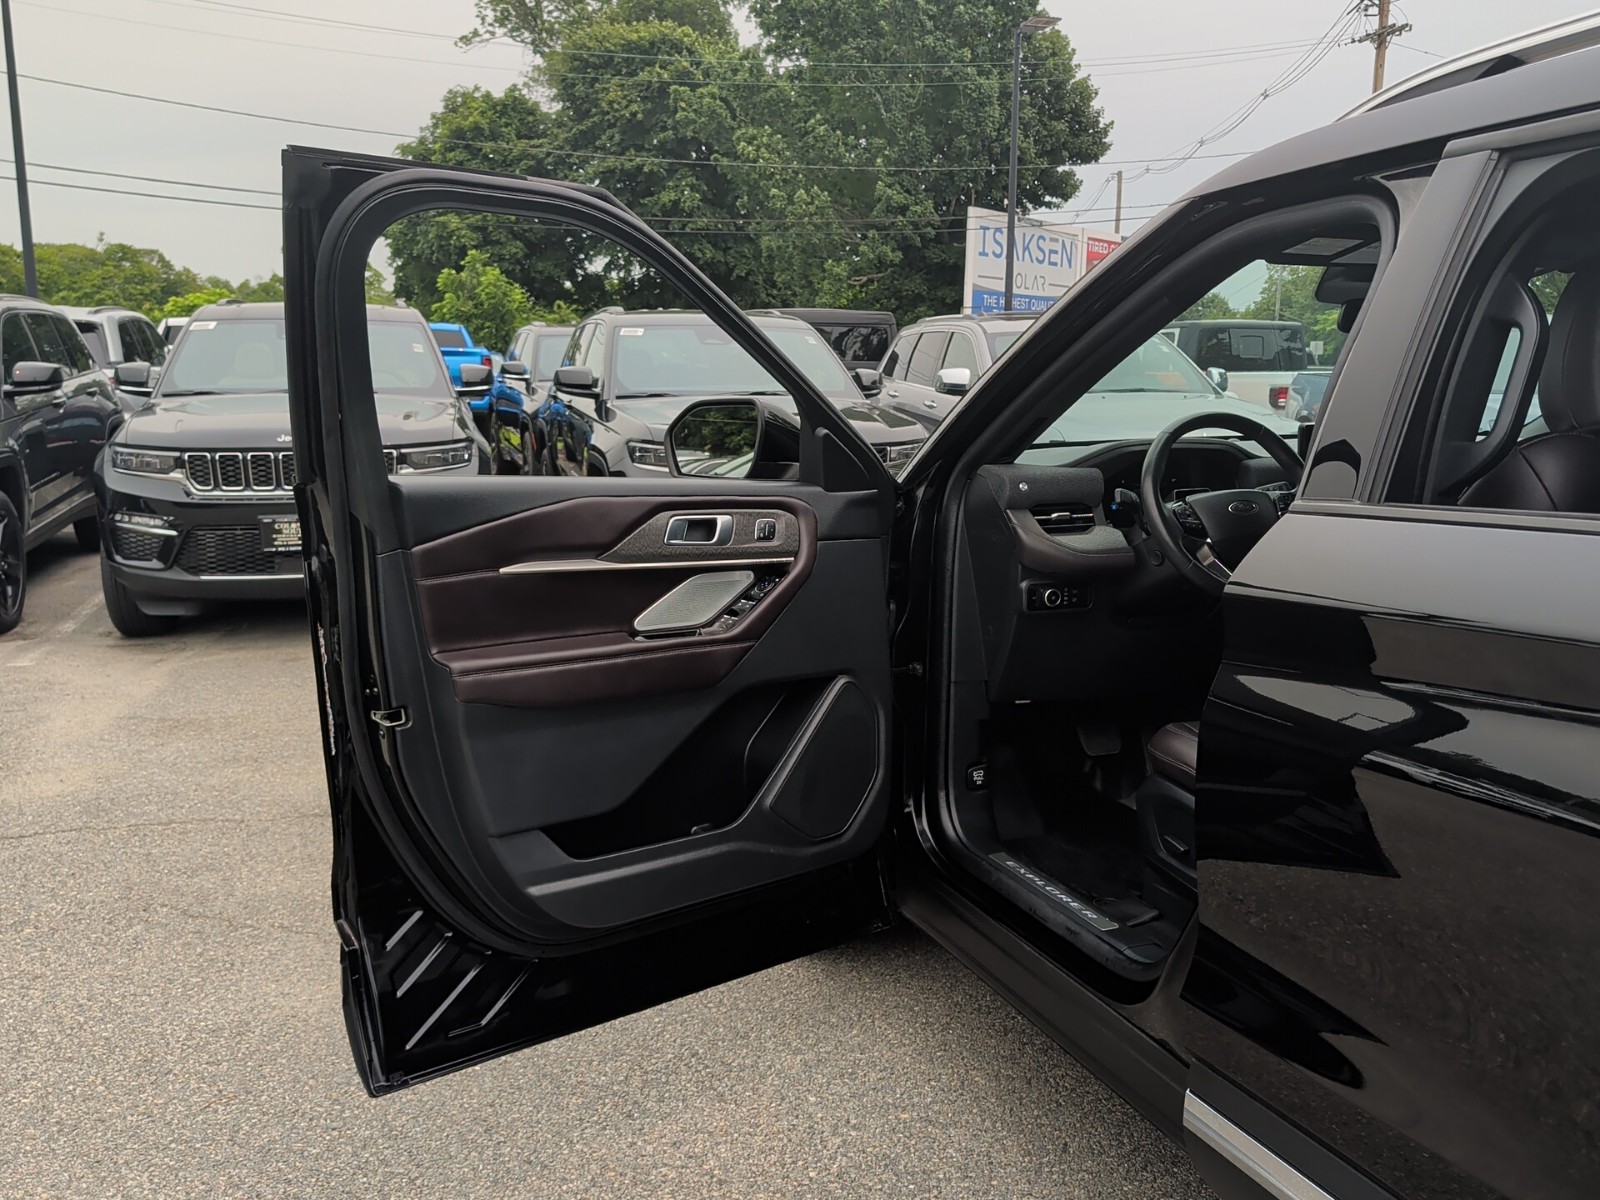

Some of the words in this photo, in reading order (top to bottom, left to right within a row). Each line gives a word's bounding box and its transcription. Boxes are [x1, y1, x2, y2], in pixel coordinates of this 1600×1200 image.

[1088, 240, 1109, 254] TIRED
[1014, 272, 1046, 291] OLAR
[983, 294, 998, 307] THE
[1000, 297, 1029, 309] HHEST
[276, 433, 293, 442] Je
[1005, 861, 1098, 919] EXPLORER
